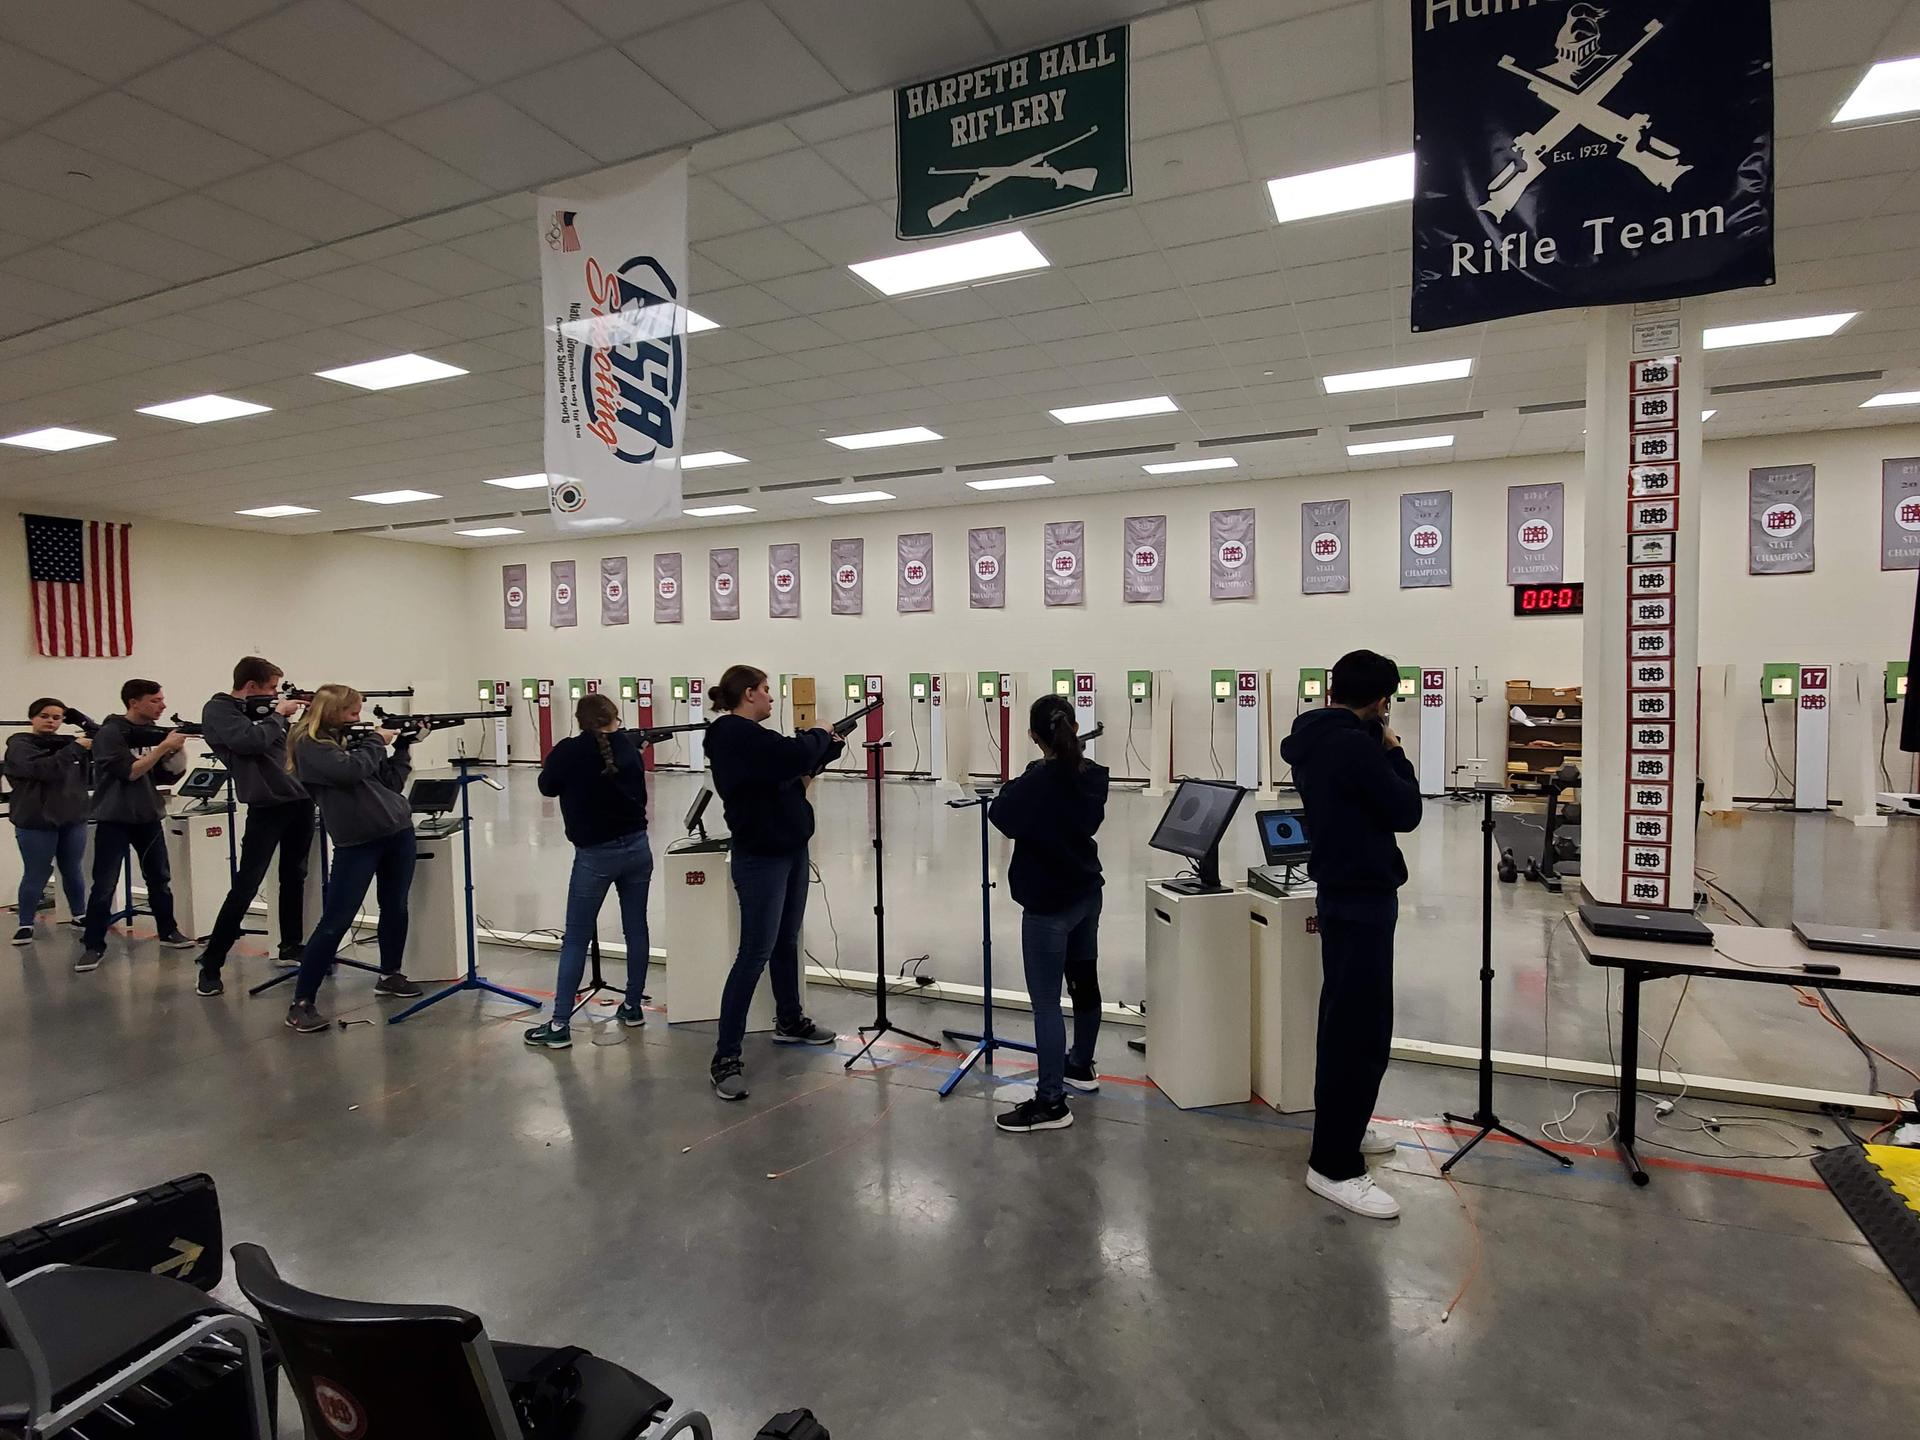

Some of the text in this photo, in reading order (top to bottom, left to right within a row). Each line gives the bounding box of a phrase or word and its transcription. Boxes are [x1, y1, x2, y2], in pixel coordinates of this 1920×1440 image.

[907, 34, 1116, 119] HARPETH HALL
[950, 88, 1067, 148] RIFLERY
[1553, 143, 1608, 163] Est. 1932
[1450, 205, 1725, 278] Rifle Team
[556, 317, 566, 353] Opic
[585, 257, 621, 453] Soting
[871, 680, 877, 690] 8
[1079, 678, 1092, 689] 11
[1240, 676, 1255, 688] 13
[1424, 674, 1442, 686] 15
[1803, 672, 1825, 685] 17
[640, 682, 648, 692] 4
[693, 680, 700, 691] 5
